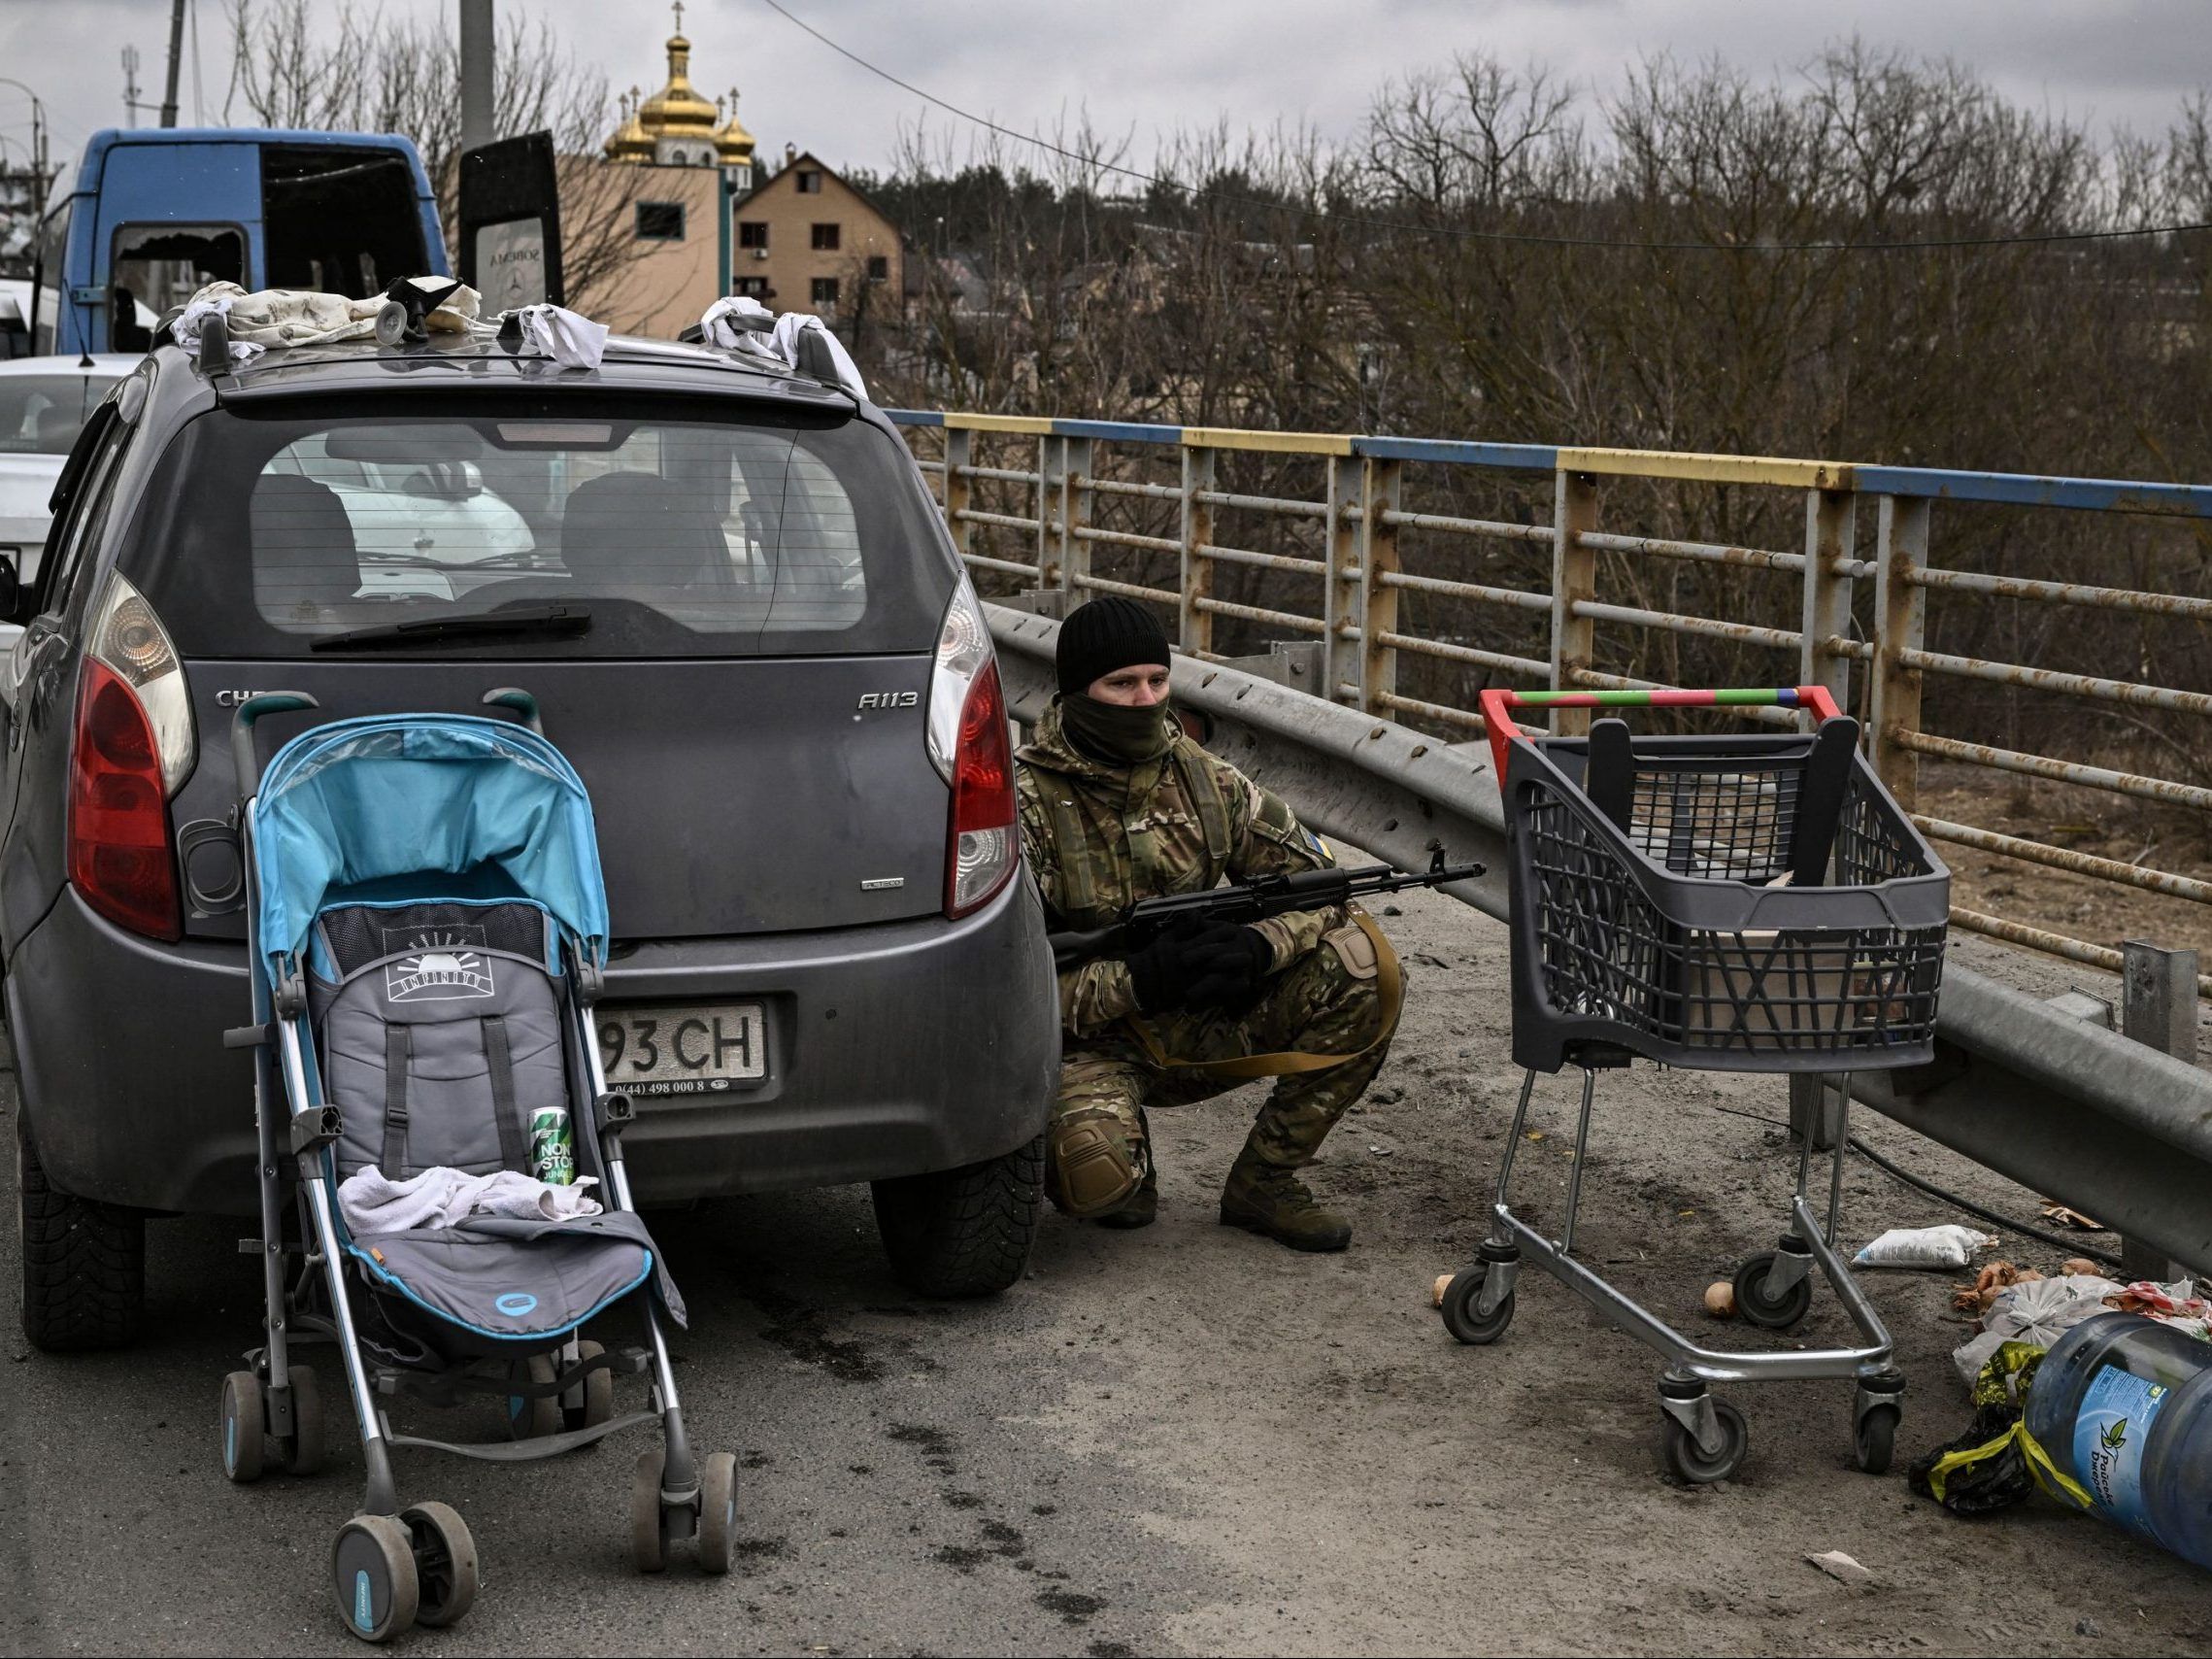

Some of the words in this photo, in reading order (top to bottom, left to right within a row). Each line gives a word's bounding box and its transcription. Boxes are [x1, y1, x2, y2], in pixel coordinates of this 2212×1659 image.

[857, 692, 919, 710] A113
[400, 971, 481, 993] INFINITY
[673, 1017, 751, 1070] CH
[649, 1082, 670, 1094] 498
[673, 1080, 694, 1093] 000
[696, 1080, 705, 1091] 8
[541, 1142, 571, 1157] NON
[541, 1156, 573, 1169] STOP
